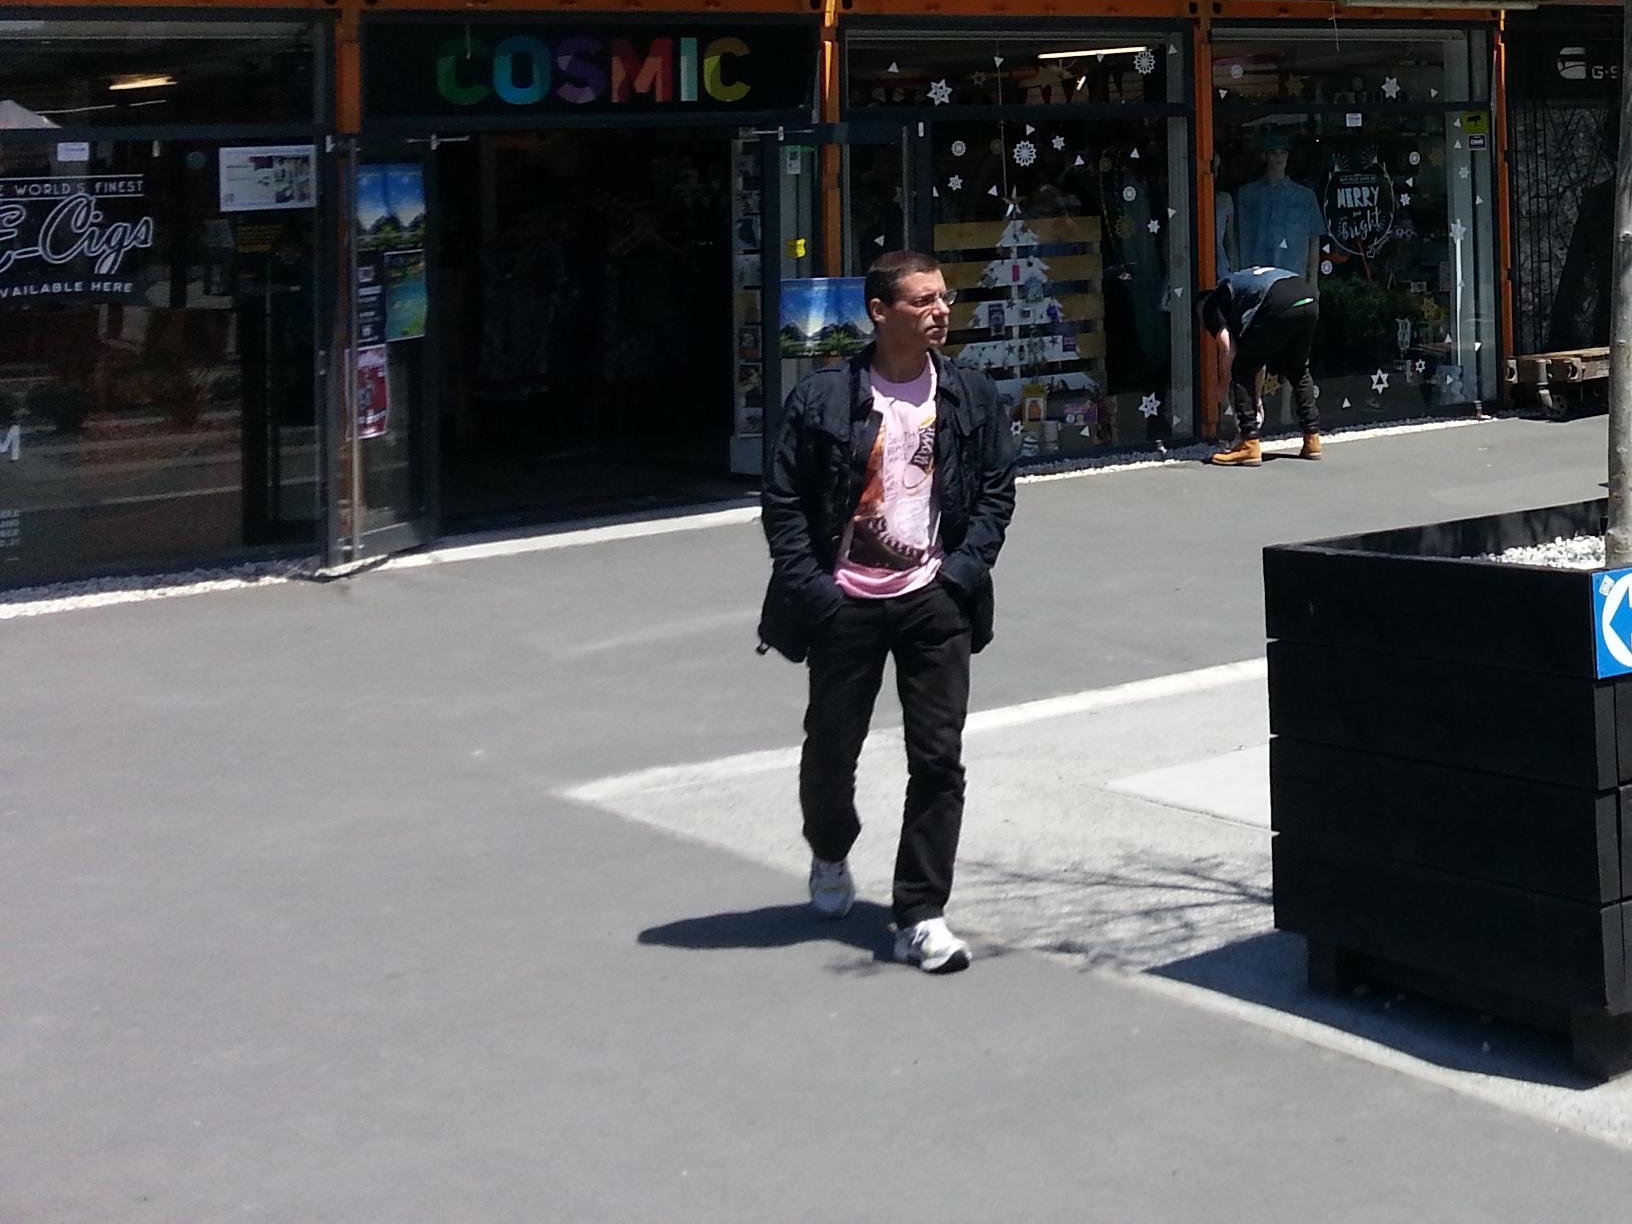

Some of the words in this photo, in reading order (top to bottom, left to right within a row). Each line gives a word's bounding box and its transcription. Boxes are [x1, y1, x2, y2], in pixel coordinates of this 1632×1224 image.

[436, 33, 751, 107] COSMIC
[14, 183, 86, 196] WORLDS
[94, 179, 144, 193] FINEST
[90, 281, 134, 293] HERE
